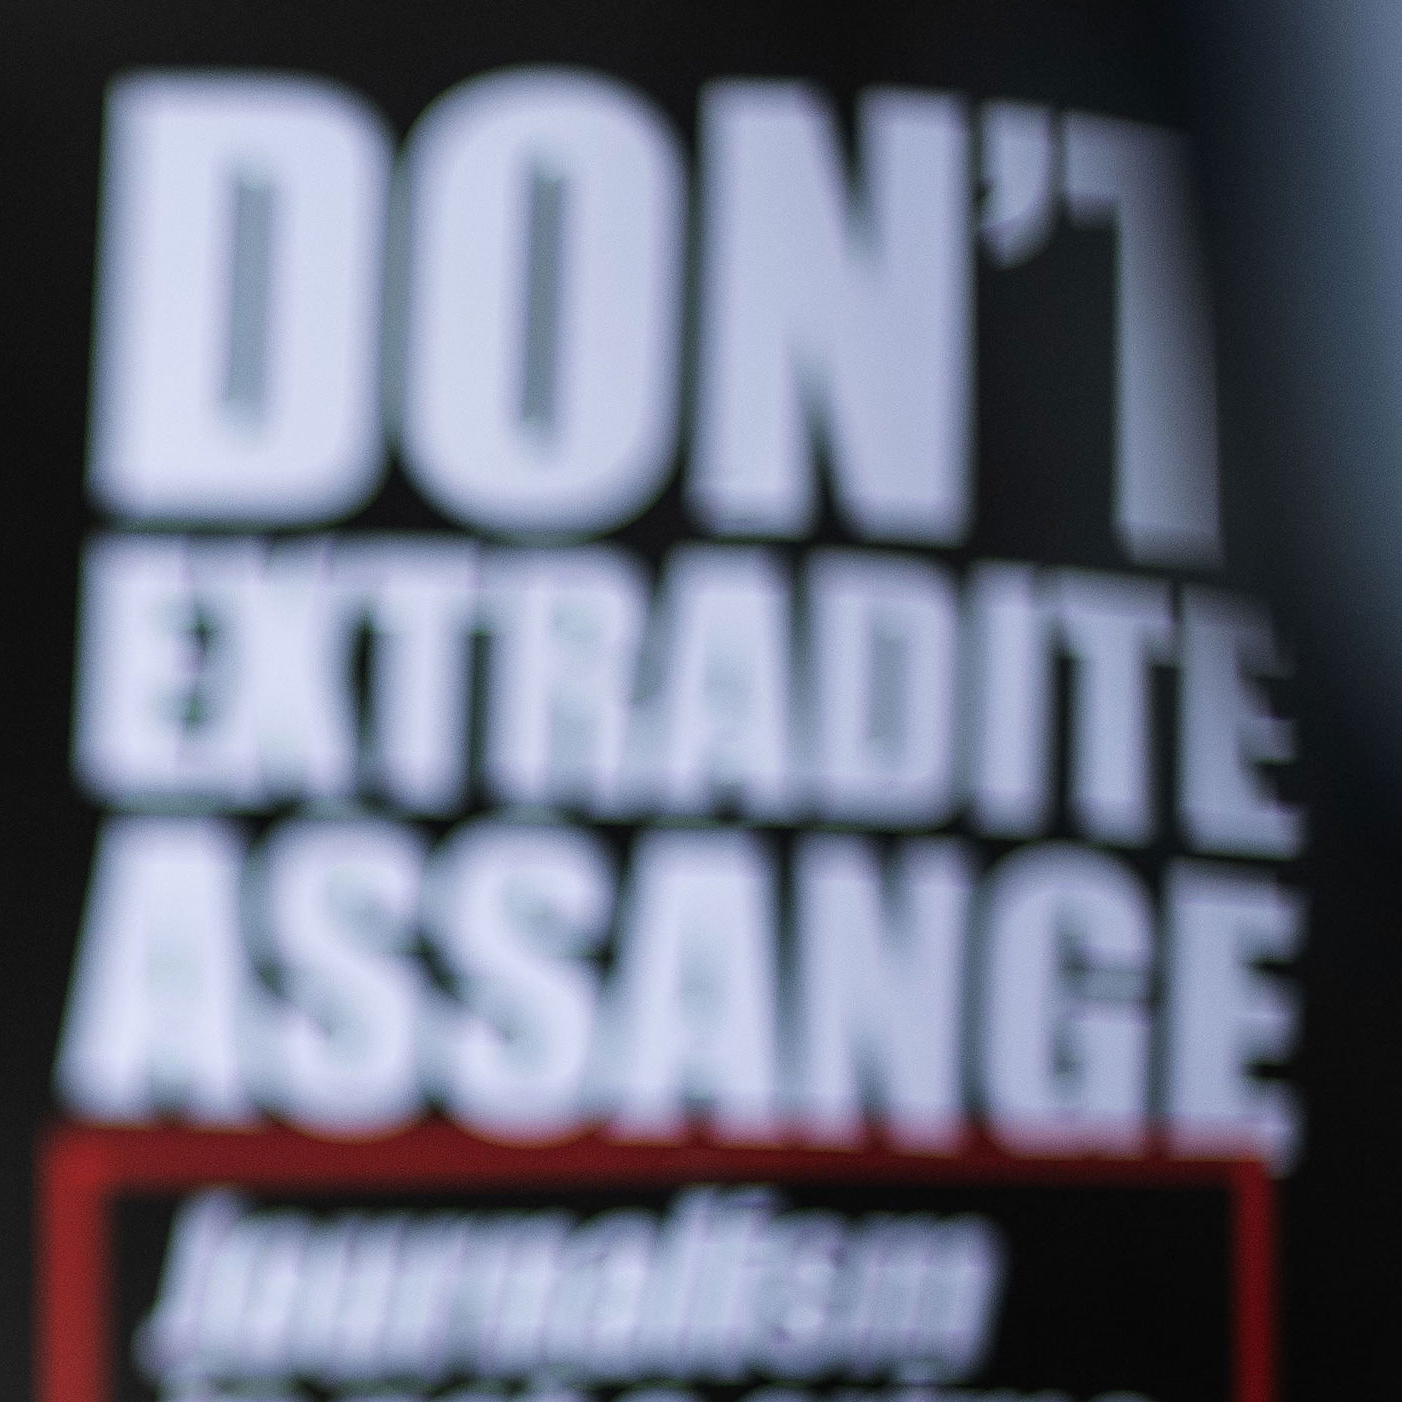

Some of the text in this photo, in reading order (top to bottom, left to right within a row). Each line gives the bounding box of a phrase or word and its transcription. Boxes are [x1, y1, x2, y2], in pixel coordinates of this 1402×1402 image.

[84, 62, 1224, 568] DON'T
[68, 535, 1302, 858] EXTRADITE
[58, 818, 1300, 1172] ASSANGE
[134, 1185, 1002, 1386] Journalism
